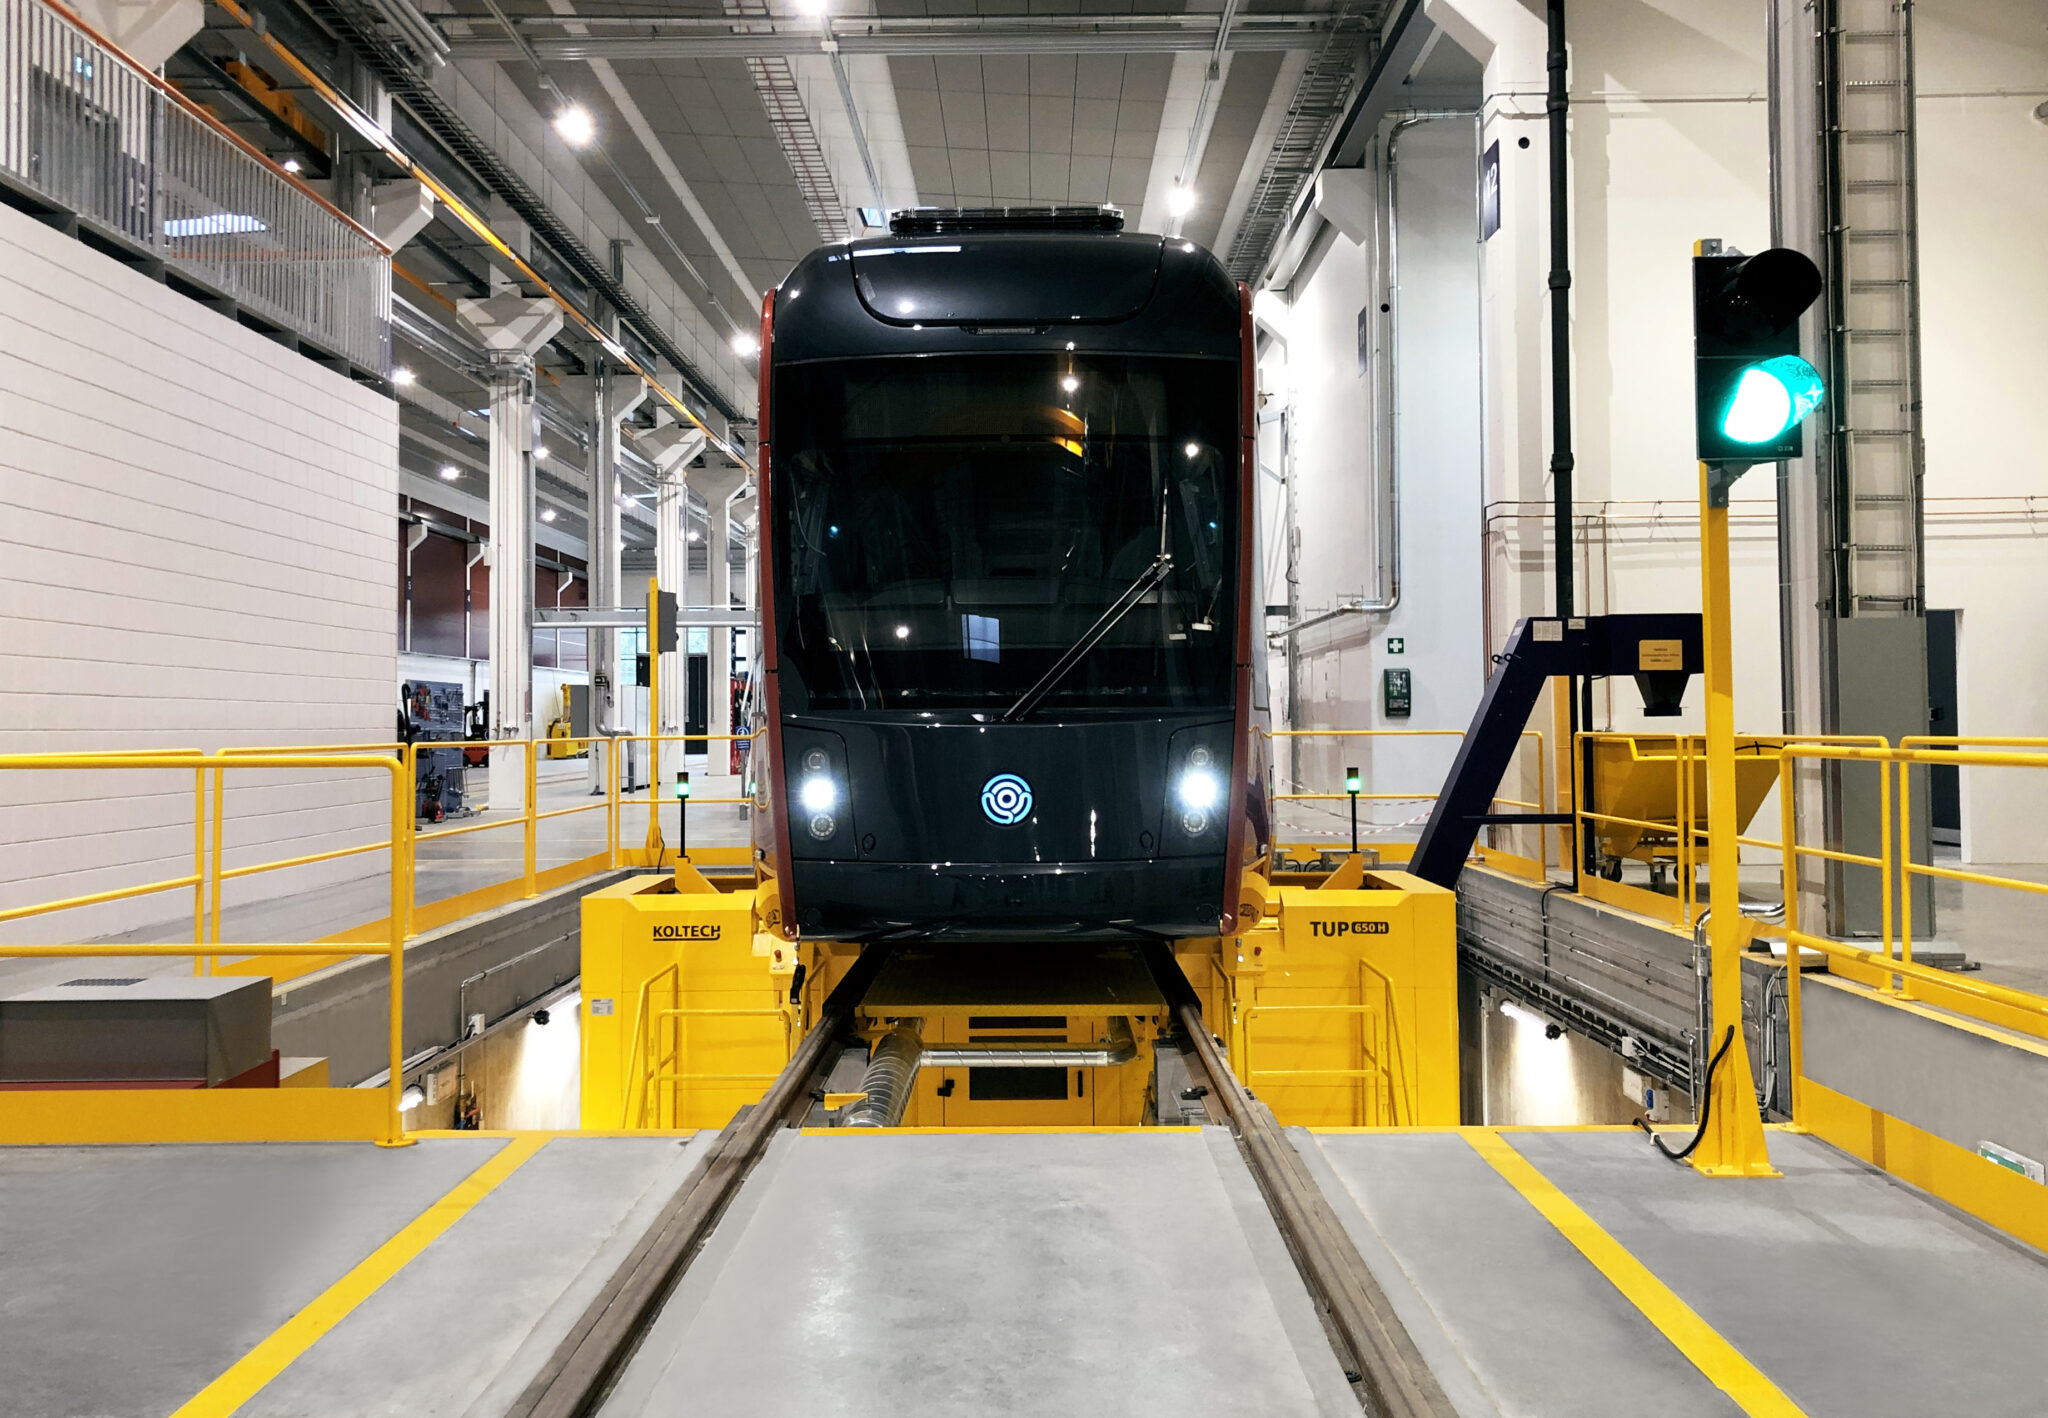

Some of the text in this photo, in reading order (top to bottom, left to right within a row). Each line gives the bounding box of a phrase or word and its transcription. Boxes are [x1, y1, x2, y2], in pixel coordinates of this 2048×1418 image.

[1485, 162, 1498, 199] 12
[653, 925, 721, 940] KOLTECH
[1309, 921, 1386, 937] TUP 650 H
